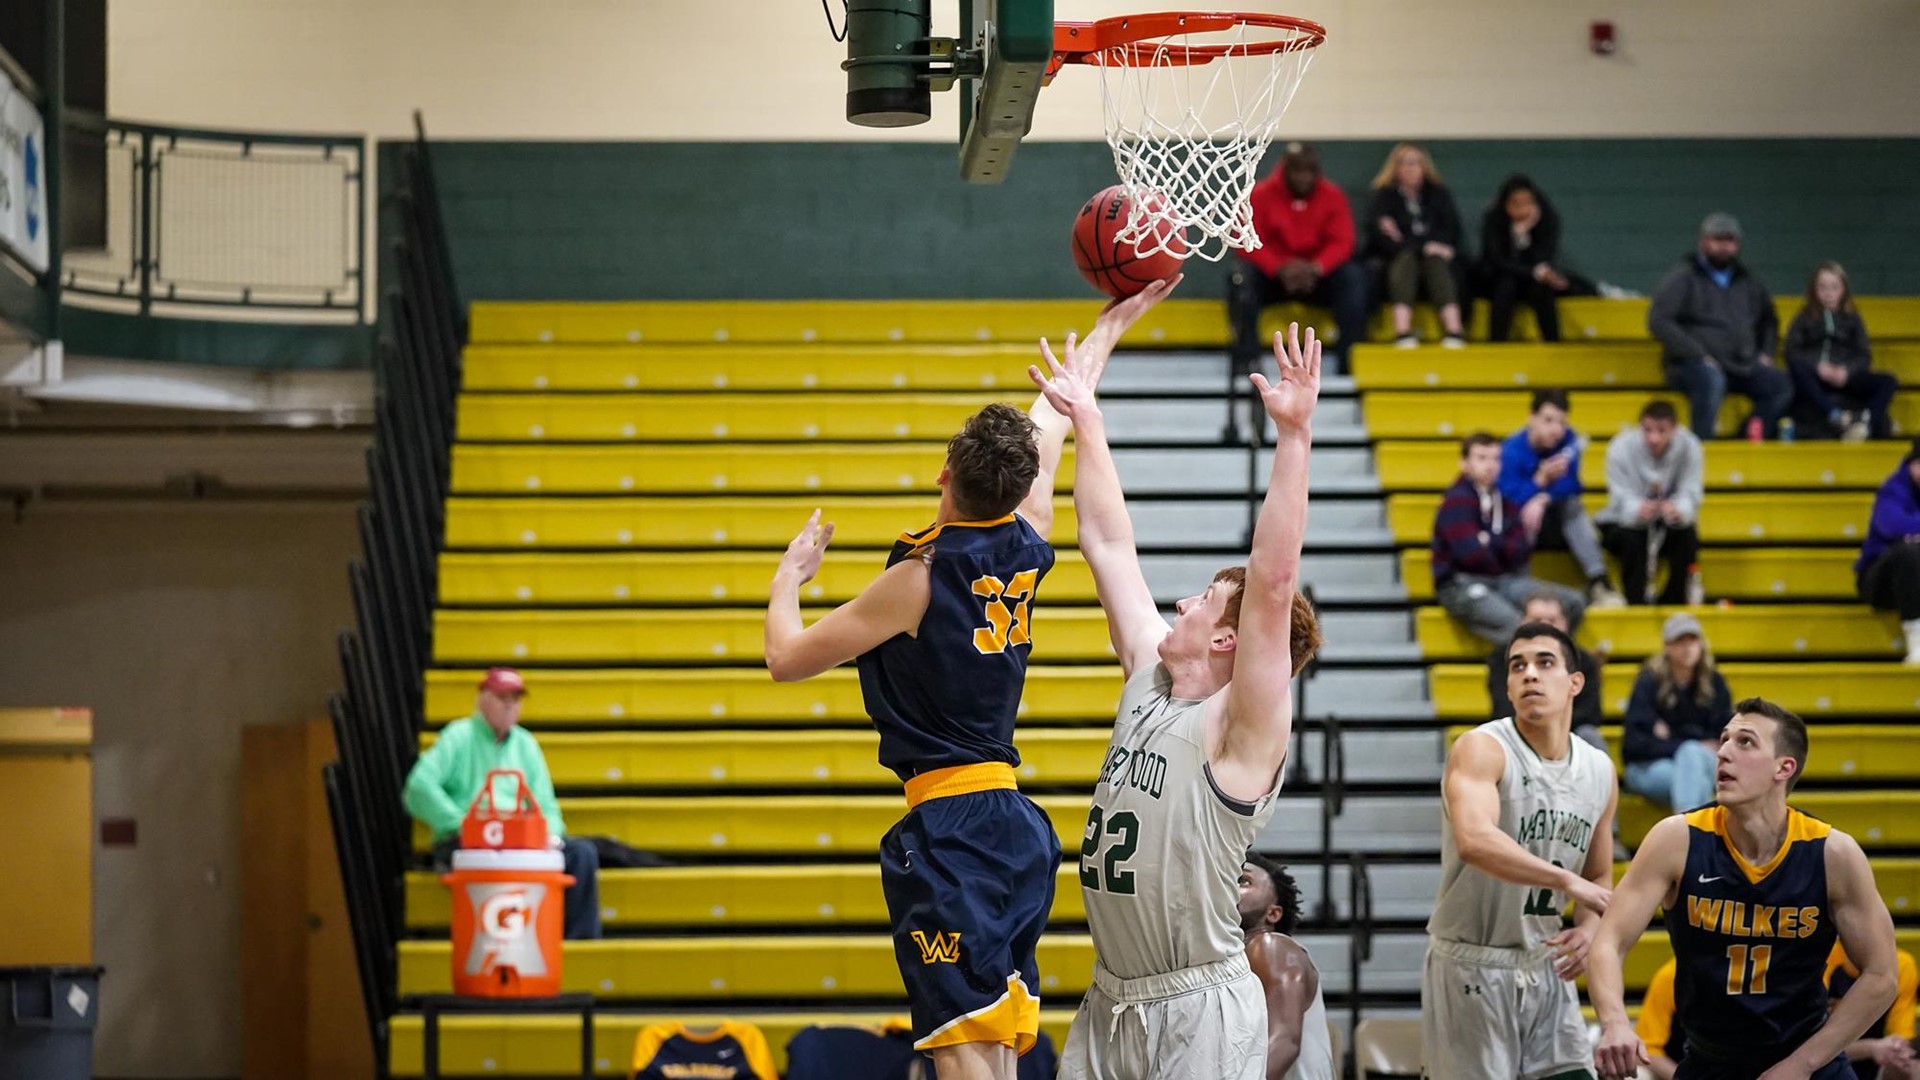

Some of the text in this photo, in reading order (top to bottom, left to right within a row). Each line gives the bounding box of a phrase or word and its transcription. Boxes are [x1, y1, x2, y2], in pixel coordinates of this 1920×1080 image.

[483, 820, 504, 846] G
[1079, 804, 1140, 895] 22
[482, 892, 526, 941] G
[1687, 894, 1820, 939] WILKES
[1726, 943, 1773, 995] 11
